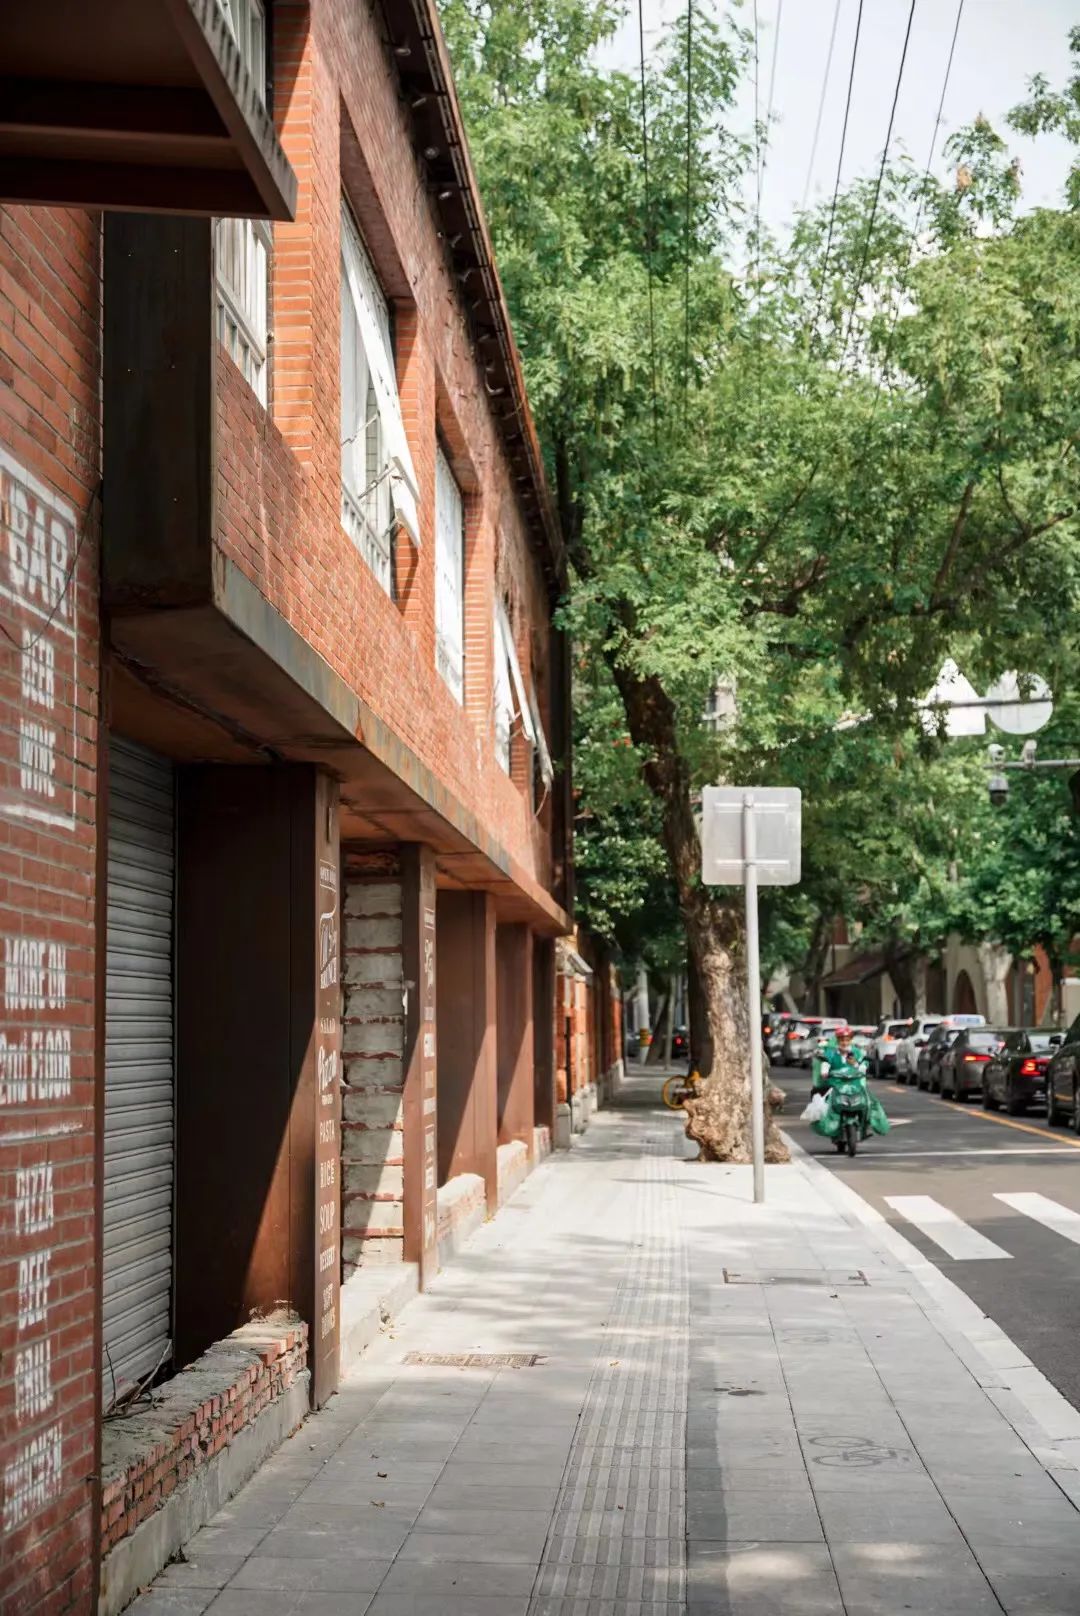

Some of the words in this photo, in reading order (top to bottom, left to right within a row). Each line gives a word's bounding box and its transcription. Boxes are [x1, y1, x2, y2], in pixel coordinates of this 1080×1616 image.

[8, 482, 68, 617] BAR
[22, 628, 54, 710] BEER
[20, 716, 55, 797] WINE
[5, 938, 46, 1010] MORE
[48, 942, 66, 1010] ON
[31, 1030, 71, 1100] FLOOR
[320, 1119, 335, 1144] PASTA
[15, 1161, 54, 1236] PIZZA
[320, 1158, 335, 1188] RICE
[320, 1200, 335, 1235] SOUP
[18, 1249, 51, 1330] BEEF
